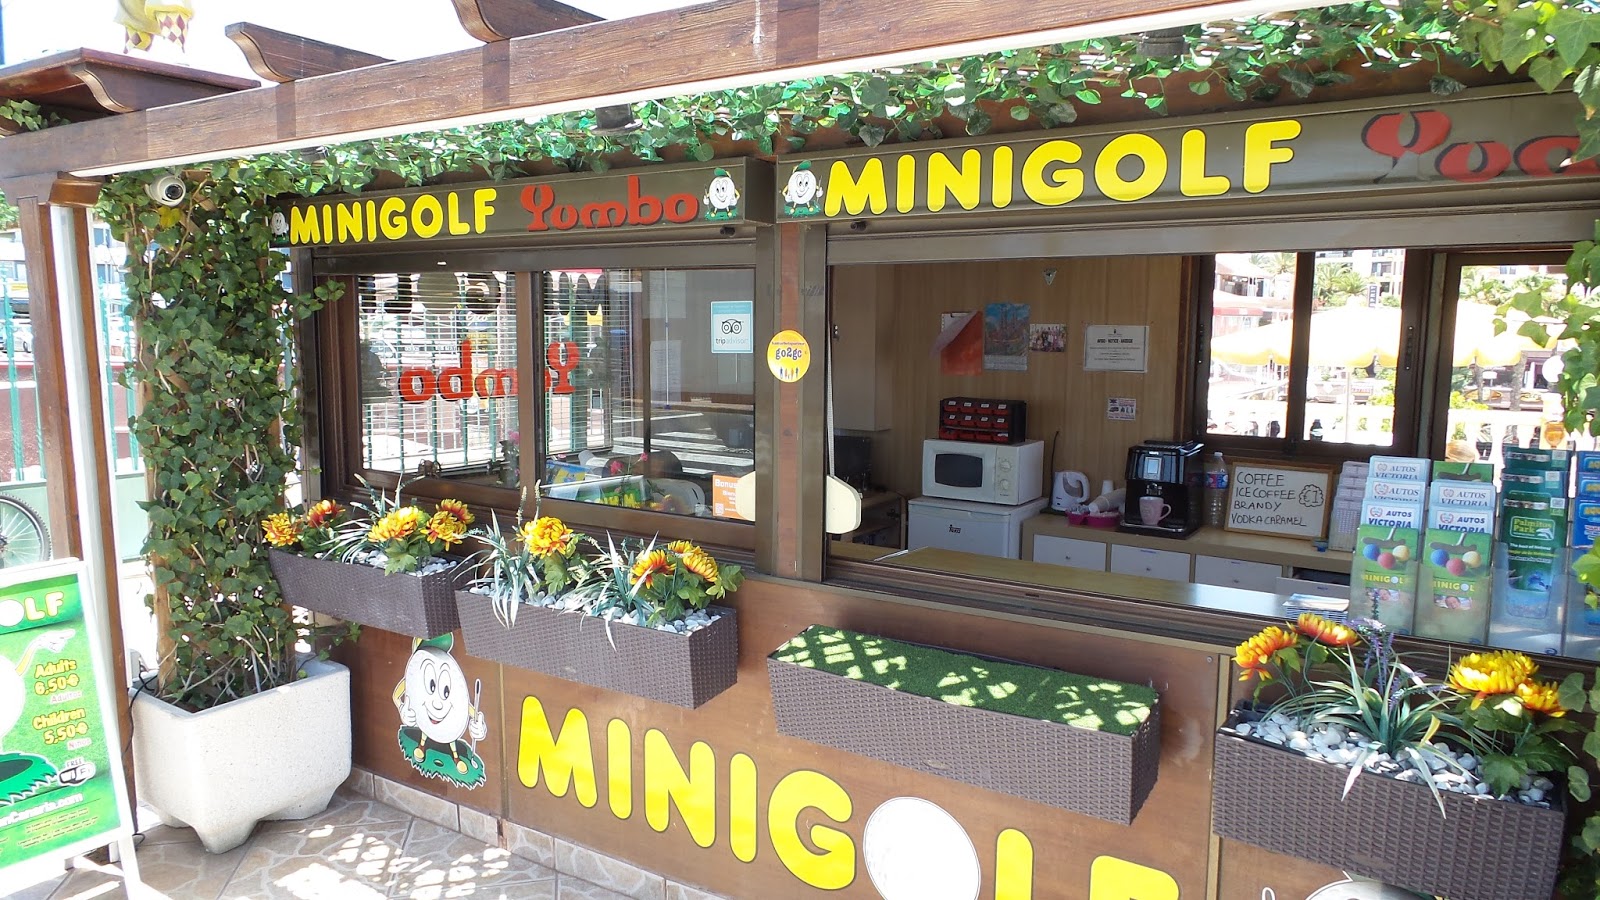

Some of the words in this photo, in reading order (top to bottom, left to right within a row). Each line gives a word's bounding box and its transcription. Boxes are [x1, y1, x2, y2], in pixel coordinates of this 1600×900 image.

[824, 119, 1302, 217] MINIGOLF
[290, 188, 498, 245] MINIGOLF
[520, 175, 699, 232] Yombo
[775, 346, 802, 361] go2gc
[1374, 471, 1419, 480] VICTORIA
[1389, 465, 1417, 473] AUTOS
[1236, 471, 1285, 487] COFFEE
[1235, 486, 1251, 498] ICE
[1254, 489, 1296, 500] COFFEE
[1388, 488, 1421, 497] AUTOS
[1456, 491, 1487, 499] AUTOS
[1234, 501, 1282, 512] BRANDY
[1231, 513, 1263, 525] VODKA
[1265, 515, 1307, 527] CARAMEL
[1385, 510, 1413, 518] AUTOS
[1456, 516, 1486, 524] AUTOS
[1367, 517, 1413, 529] VICTORIA
[1513, 524, 1536, 533] Park
[34, 659, 77, 679] Adults
[34, 673, 80, 696] 6,50€
[32, 708, 87, 730] Children
[43, 721, 89, 745] 5,50€
[66, 758, 82, 767] FREE
